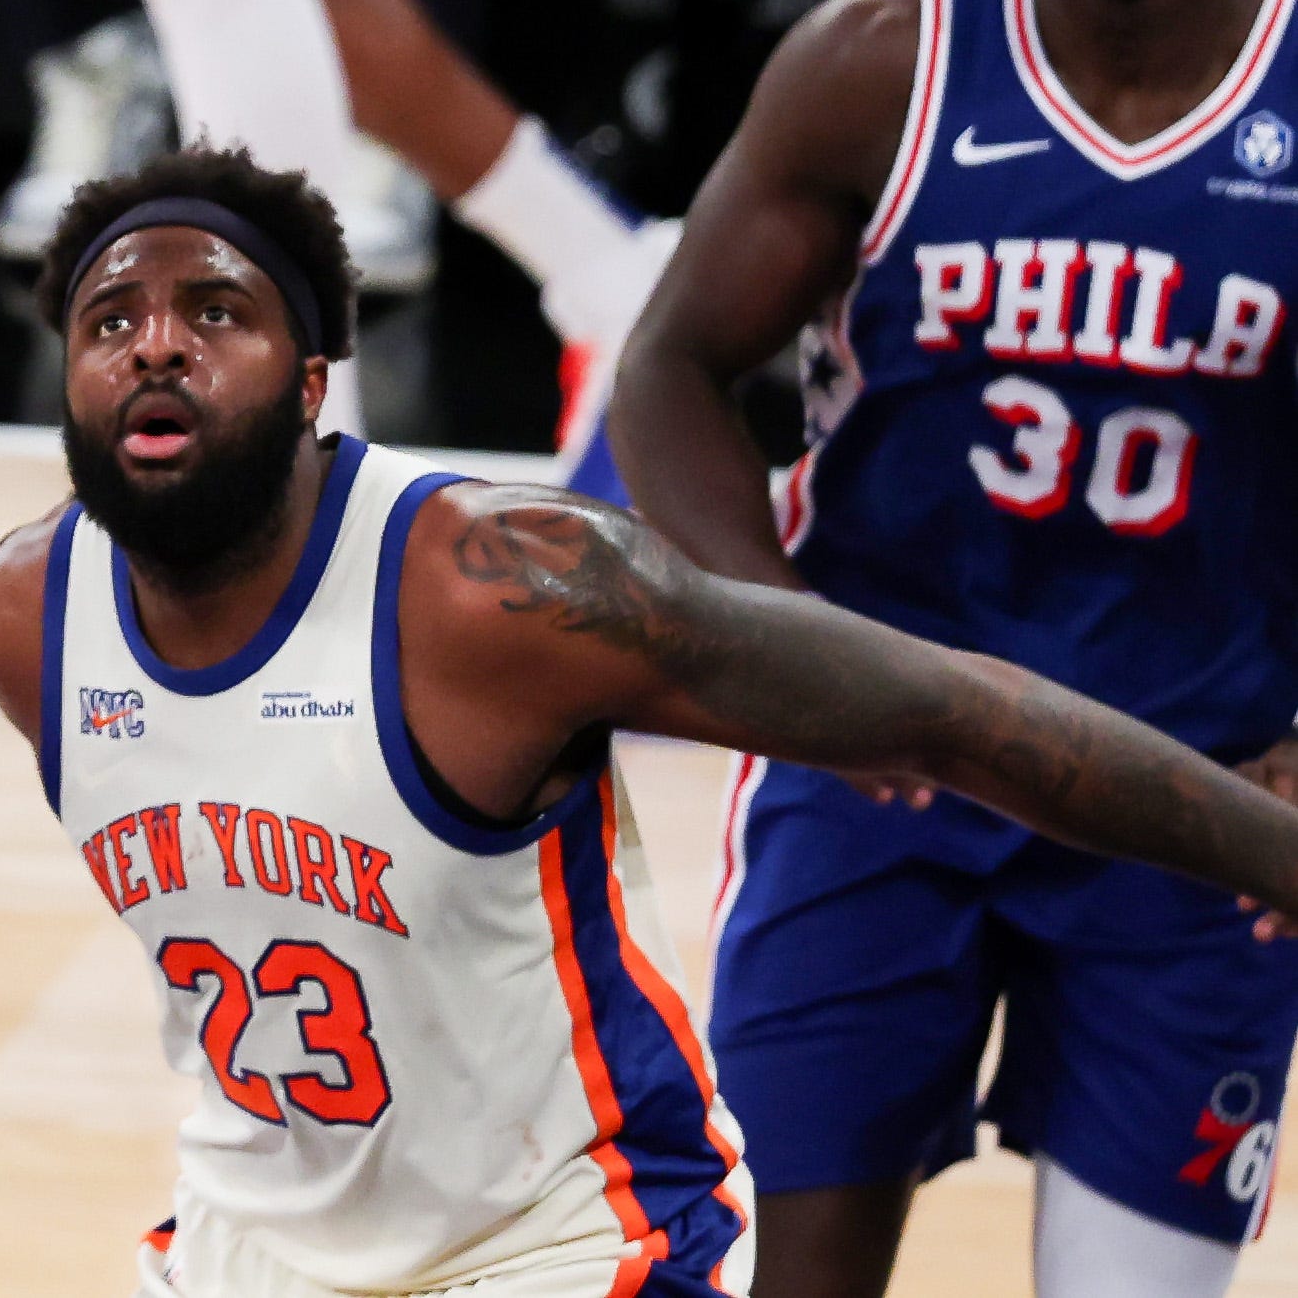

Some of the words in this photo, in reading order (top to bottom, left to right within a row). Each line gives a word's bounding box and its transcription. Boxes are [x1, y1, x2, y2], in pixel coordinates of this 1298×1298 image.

[915, 238, 1286, 377] PHILA
[967, 373, 1201, 537] 30
[78, 685, 146, 740] NYC
[261, 696, 297, 718] abu
[300, 699, 355, 718] dhabi
[81, 802, 188, 917] NEW
[197, 802, 410, 939] YORK
[157, 936, 393, 1128] 23
[1178, 1106, 1275, 1202] 76
